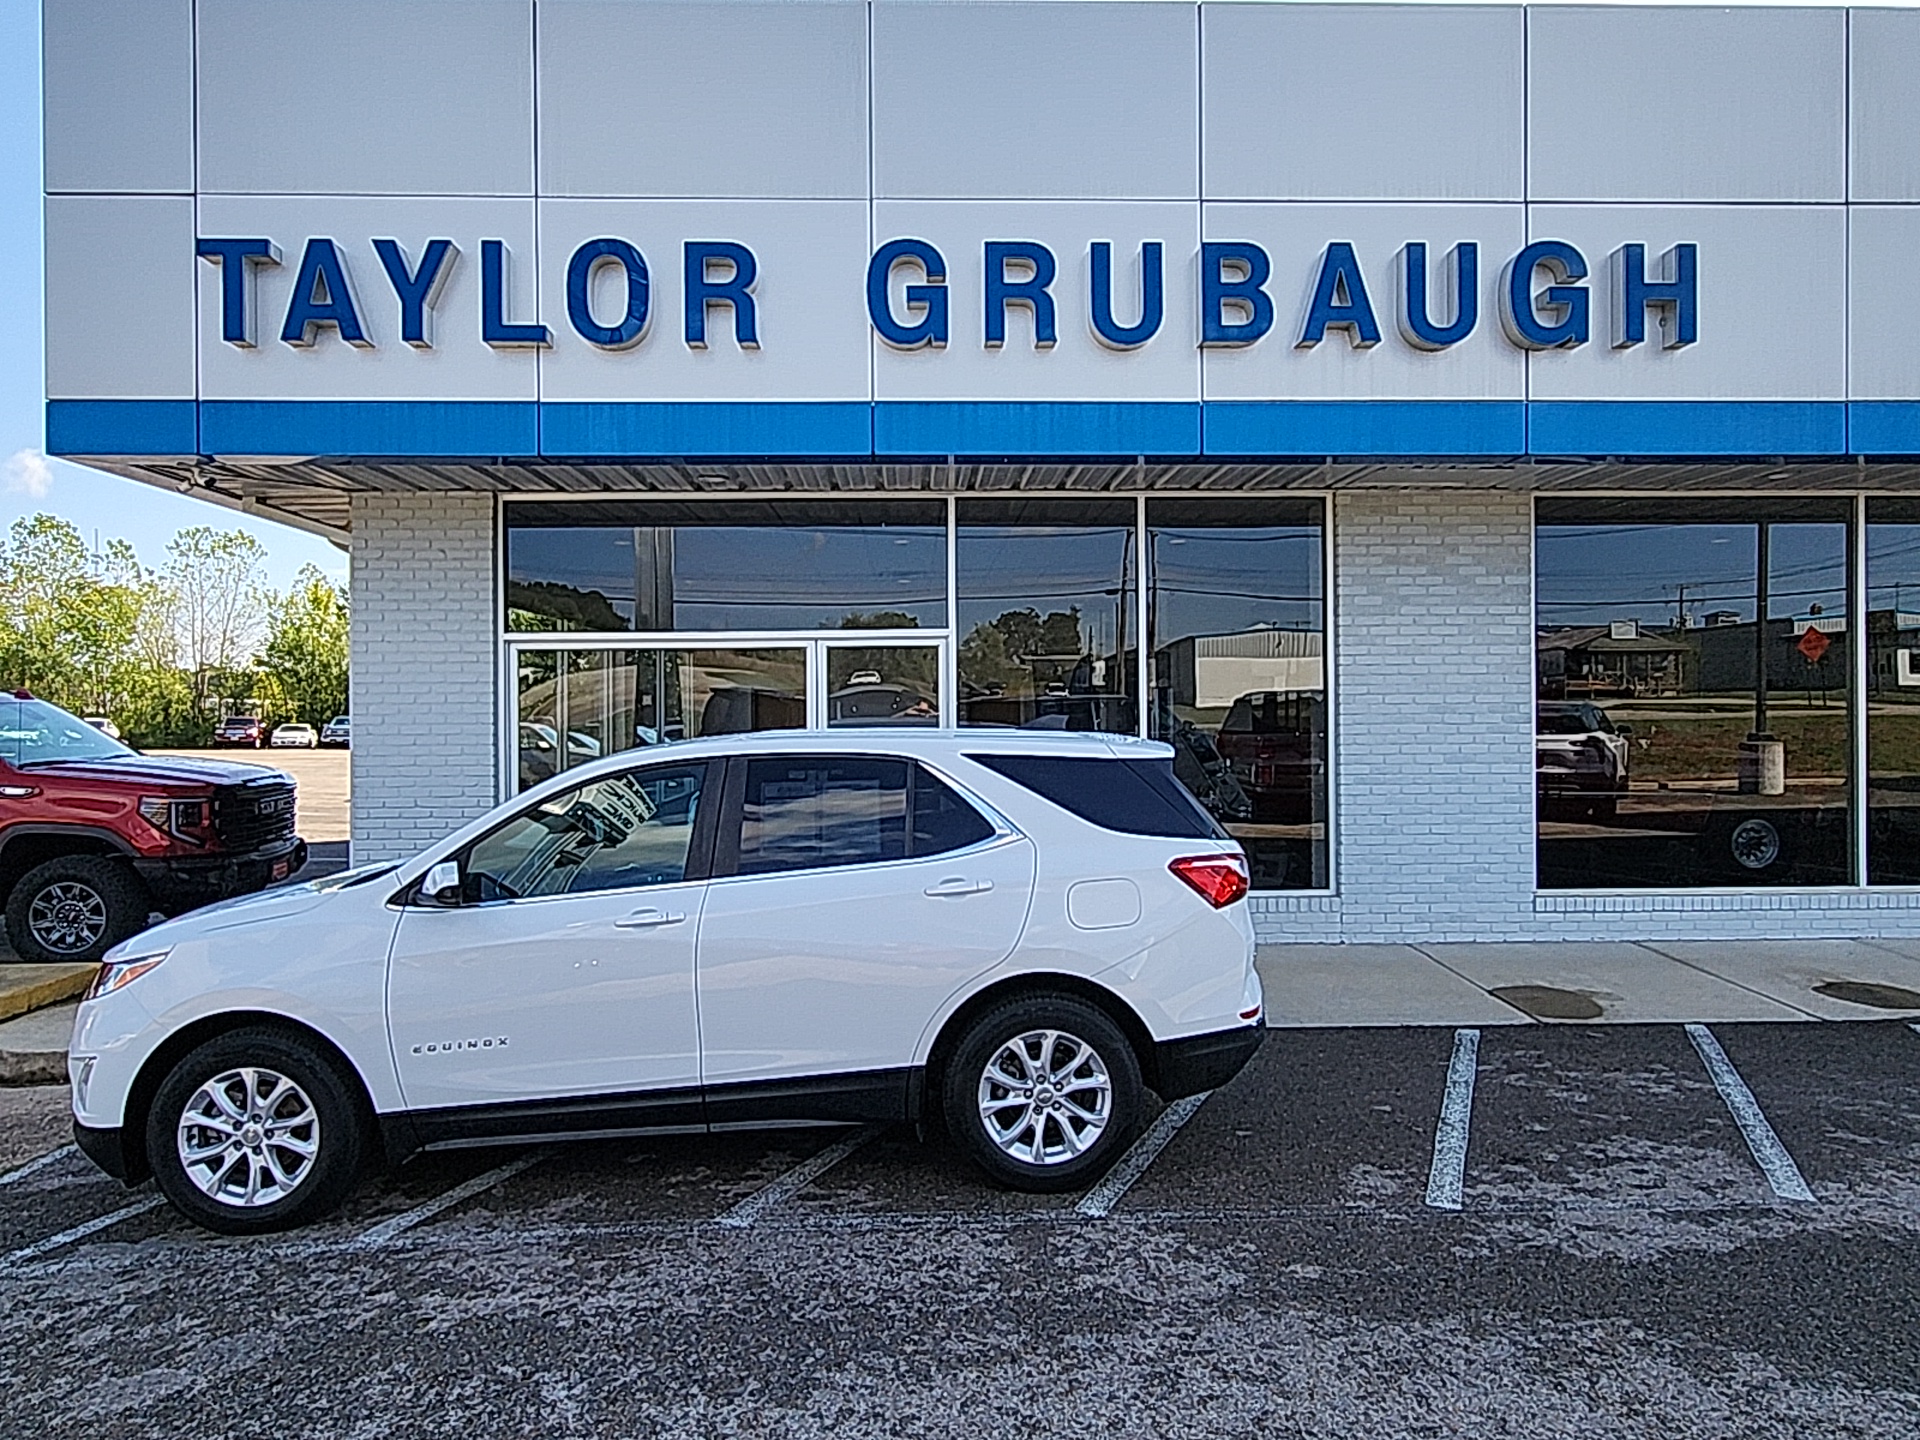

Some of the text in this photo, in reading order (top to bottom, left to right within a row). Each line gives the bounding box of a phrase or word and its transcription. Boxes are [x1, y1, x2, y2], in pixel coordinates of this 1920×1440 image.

[196, 238, 1699, 350] TAYLOR GRUBAUGH
[411, 1037, 509, 1054] EQUINOX
